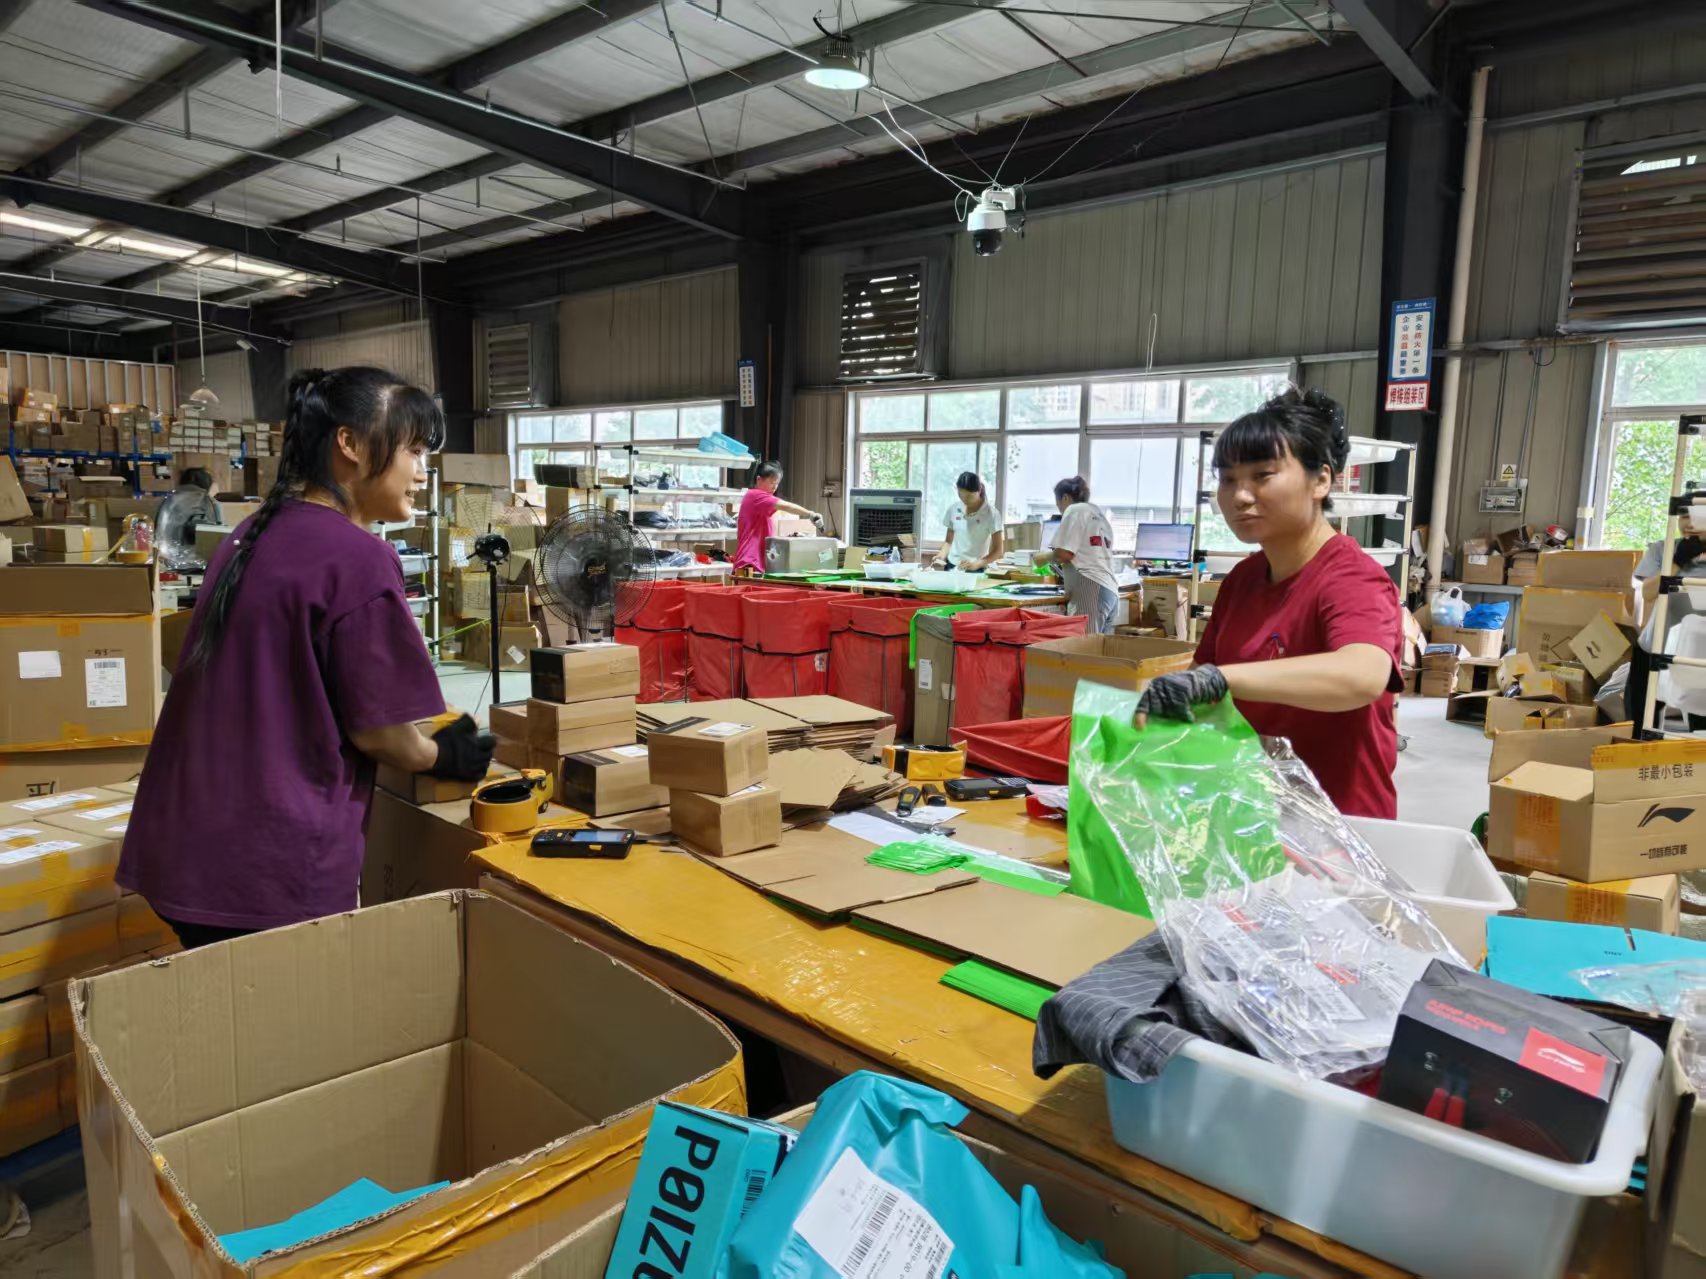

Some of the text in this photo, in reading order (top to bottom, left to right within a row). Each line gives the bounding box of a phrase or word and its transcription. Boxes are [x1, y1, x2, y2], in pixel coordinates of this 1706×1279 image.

[1638, 763, 1693, 781] 非最小包装
